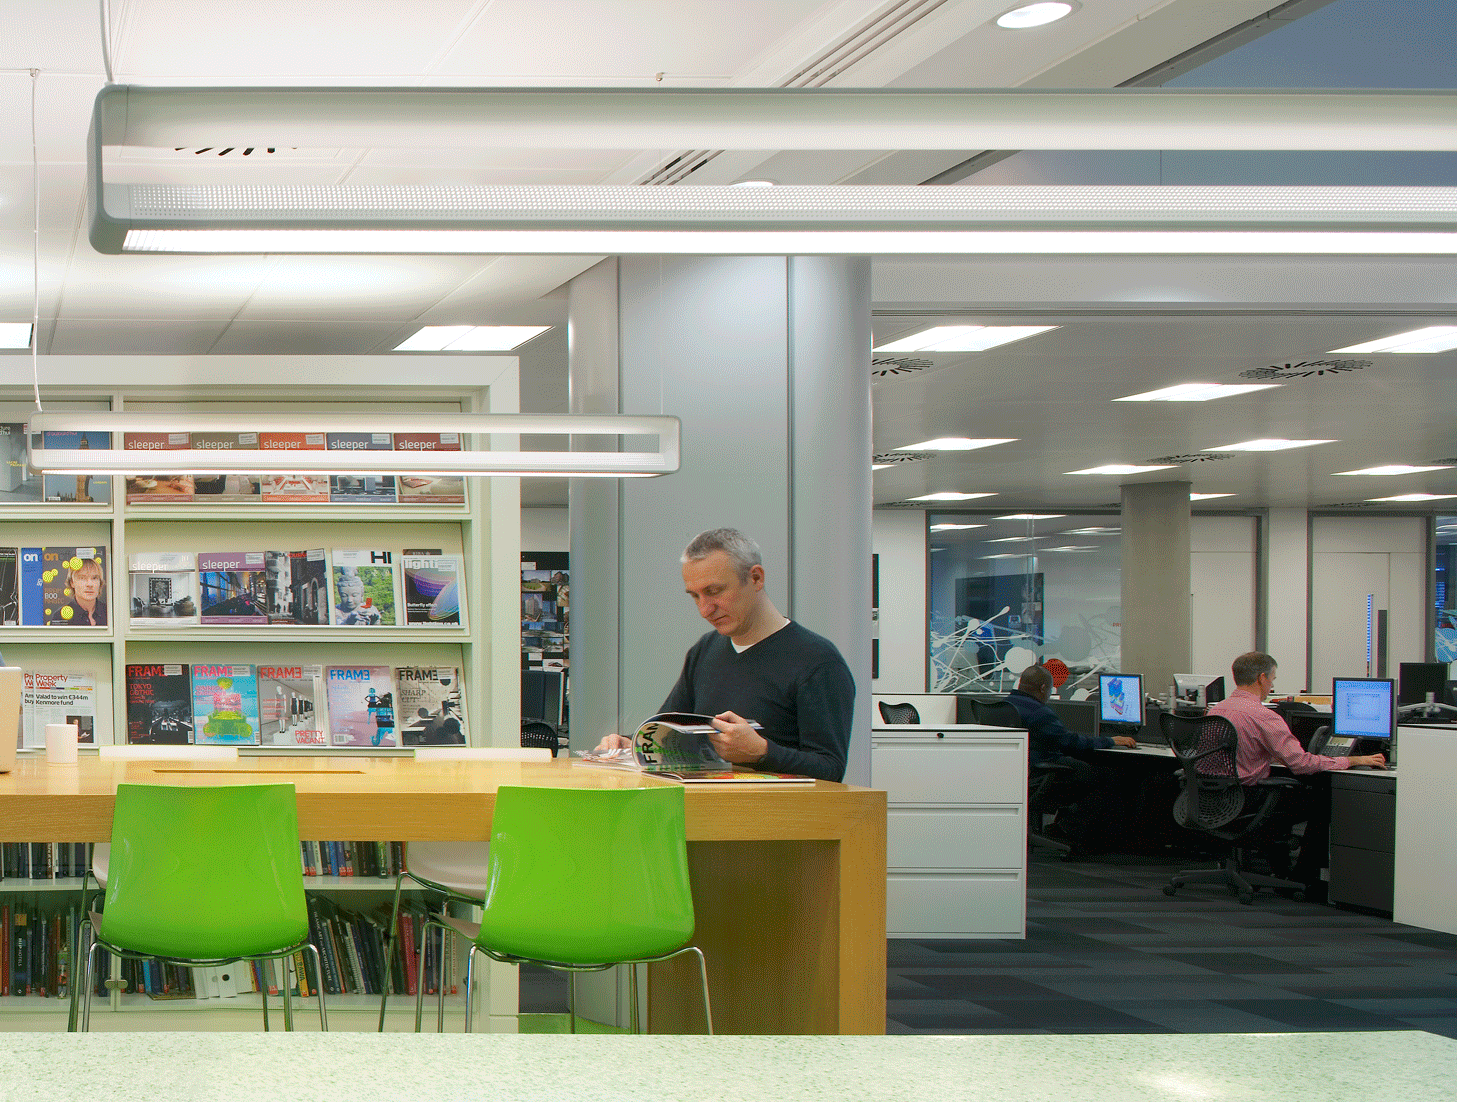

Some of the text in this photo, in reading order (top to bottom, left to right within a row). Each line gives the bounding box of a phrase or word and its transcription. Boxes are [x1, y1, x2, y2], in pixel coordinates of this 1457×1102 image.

[128, 439, 165, 450] sleeper
[196, 439, 235, 450] sleeper
[264, 439, 301, 450] sleeper
[331, 439, 369, 450] sleeper
[399, 439, 437, 450] sleeper
[202, 560, 240, 572] sleeper
[35, 673, 68, 682] Property
